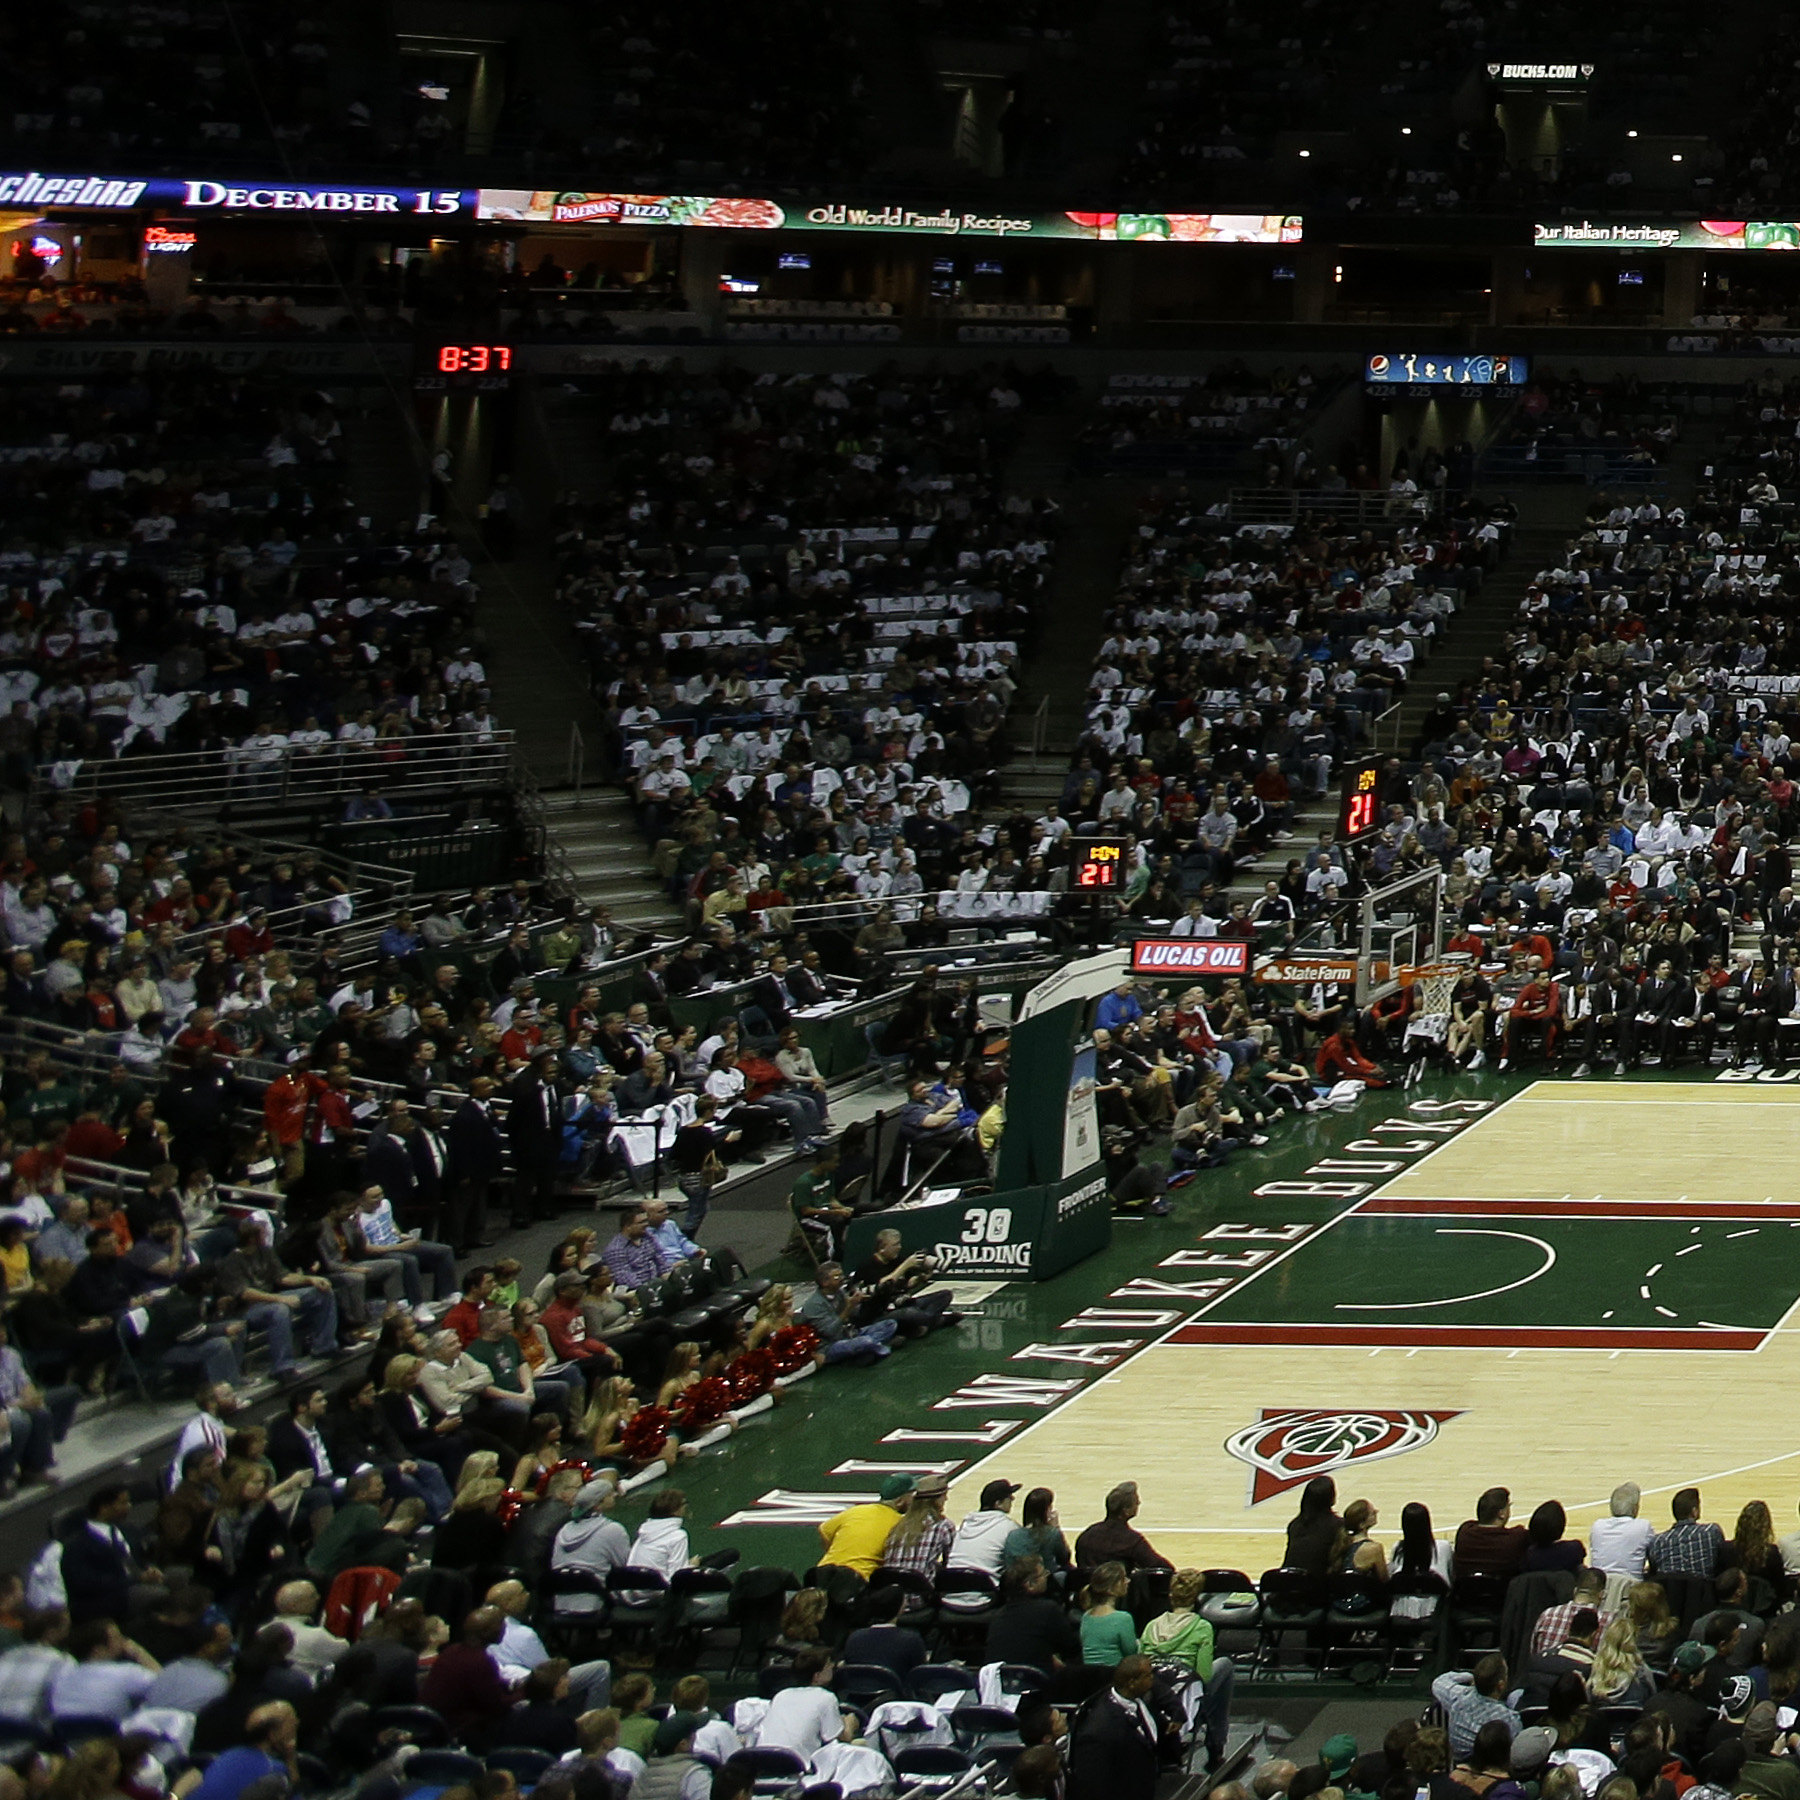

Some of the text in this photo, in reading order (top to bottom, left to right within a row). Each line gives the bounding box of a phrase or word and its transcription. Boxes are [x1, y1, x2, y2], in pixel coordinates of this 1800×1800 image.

[1503, 65, 1577, 78] BUCKS.COM
[414, 191, 461, 214] 15
[623, 203, 669, 218] PIZZA
[807, 205, 1031, 236] Old World Family Recipes
[1562, 220, 1680, 247] Italian Heritage
[439, 346, 512, 372] 8:37
[1081, 863, 1110, 885] 21
[1139, 946, 1243, 966] LUCAS OIL
[1283, 965, 1352, 981] StateFarm
[1251, 1098, 1492, 1199] BUCKS
[1058, 1177, 1107, 1214] FRONTIER
[935, 1242, 1032, 1273] SPALDING
